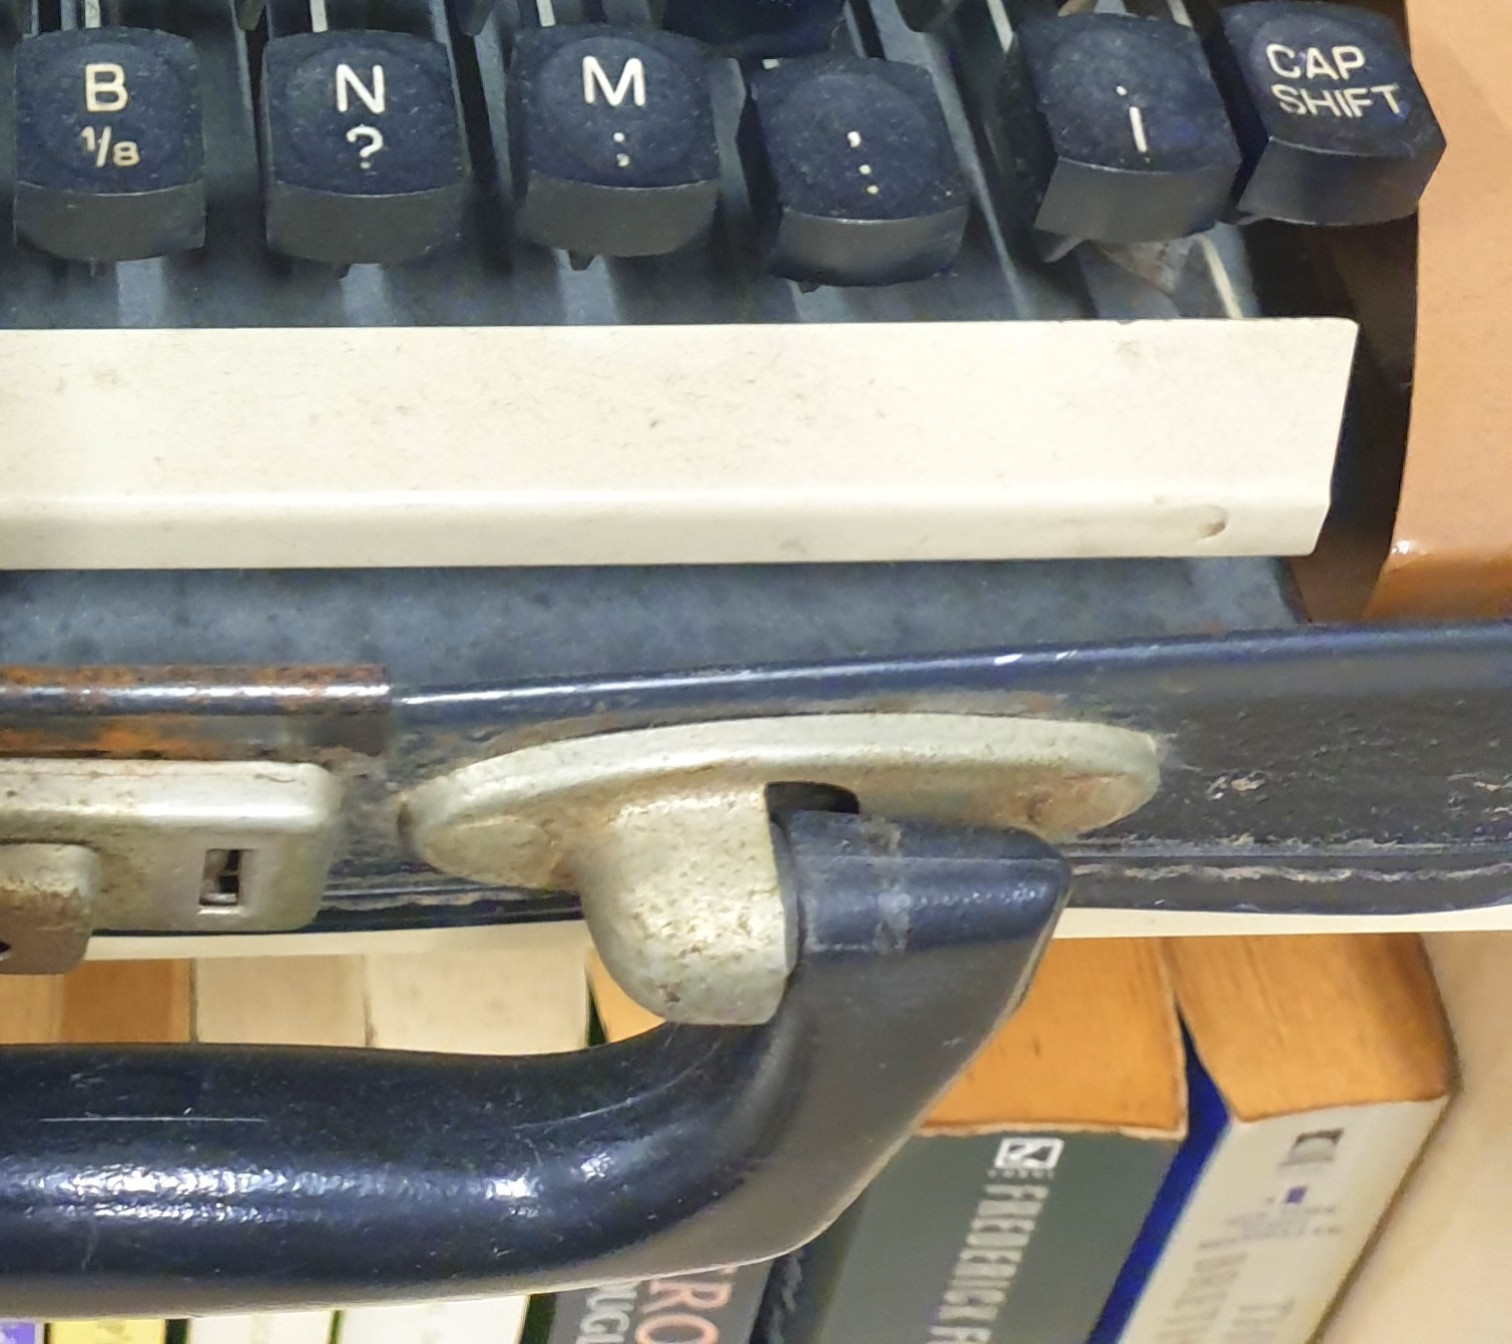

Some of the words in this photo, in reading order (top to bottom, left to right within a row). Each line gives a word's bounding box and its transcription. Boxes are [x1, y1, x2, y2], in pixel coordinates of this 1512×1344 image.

[582, 55, 646, 107] M
[1265, 43, 1366, 80] CAP
[85, 62, 128, 112] B
[335, 63, 385, 114] N
[1270, 82, 1403, 120] SHIFT
[346, 124, 384, 169] ?
